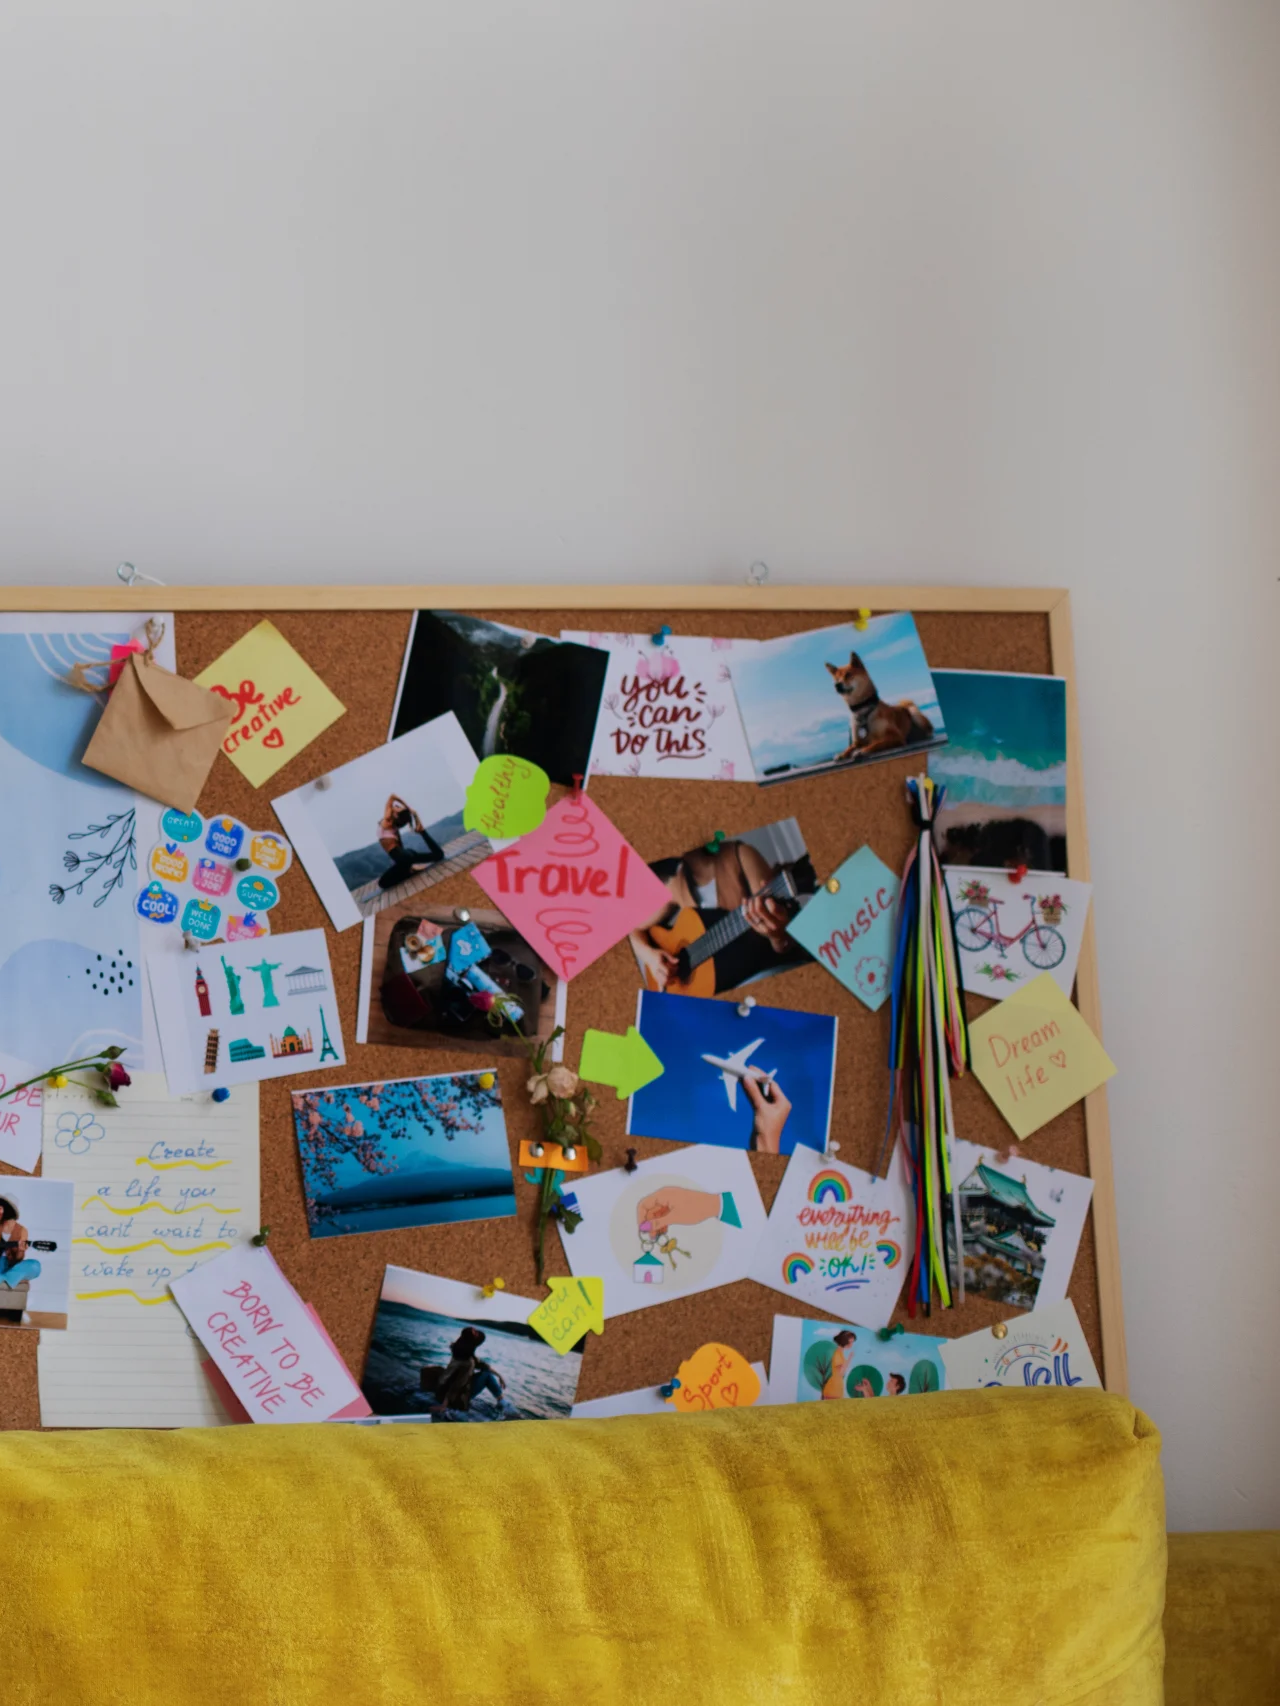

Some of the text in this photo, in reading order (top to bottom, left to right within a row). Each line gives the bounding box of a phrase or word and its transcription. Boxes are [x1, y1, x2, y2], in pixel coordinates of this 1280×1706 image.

[486, 845, 629, 898] Travel
[141, 899, 176, 915] COOL!
[987, 1020, 1061, 1068] Dream
[8, 1082, 43, 1107] BE
[148, 1140, 217, 1160] Create
[97, 1176, 216, 1214] a life you
[152, 1217, 204, 1239] wait
[217, 1220, 238, 1239] to
[82, 1256, 172, 1288] wake up
[223, 1280, 325, 1408] BORN TO BE
[207, 1312, 286, 1414] CREATIVE
